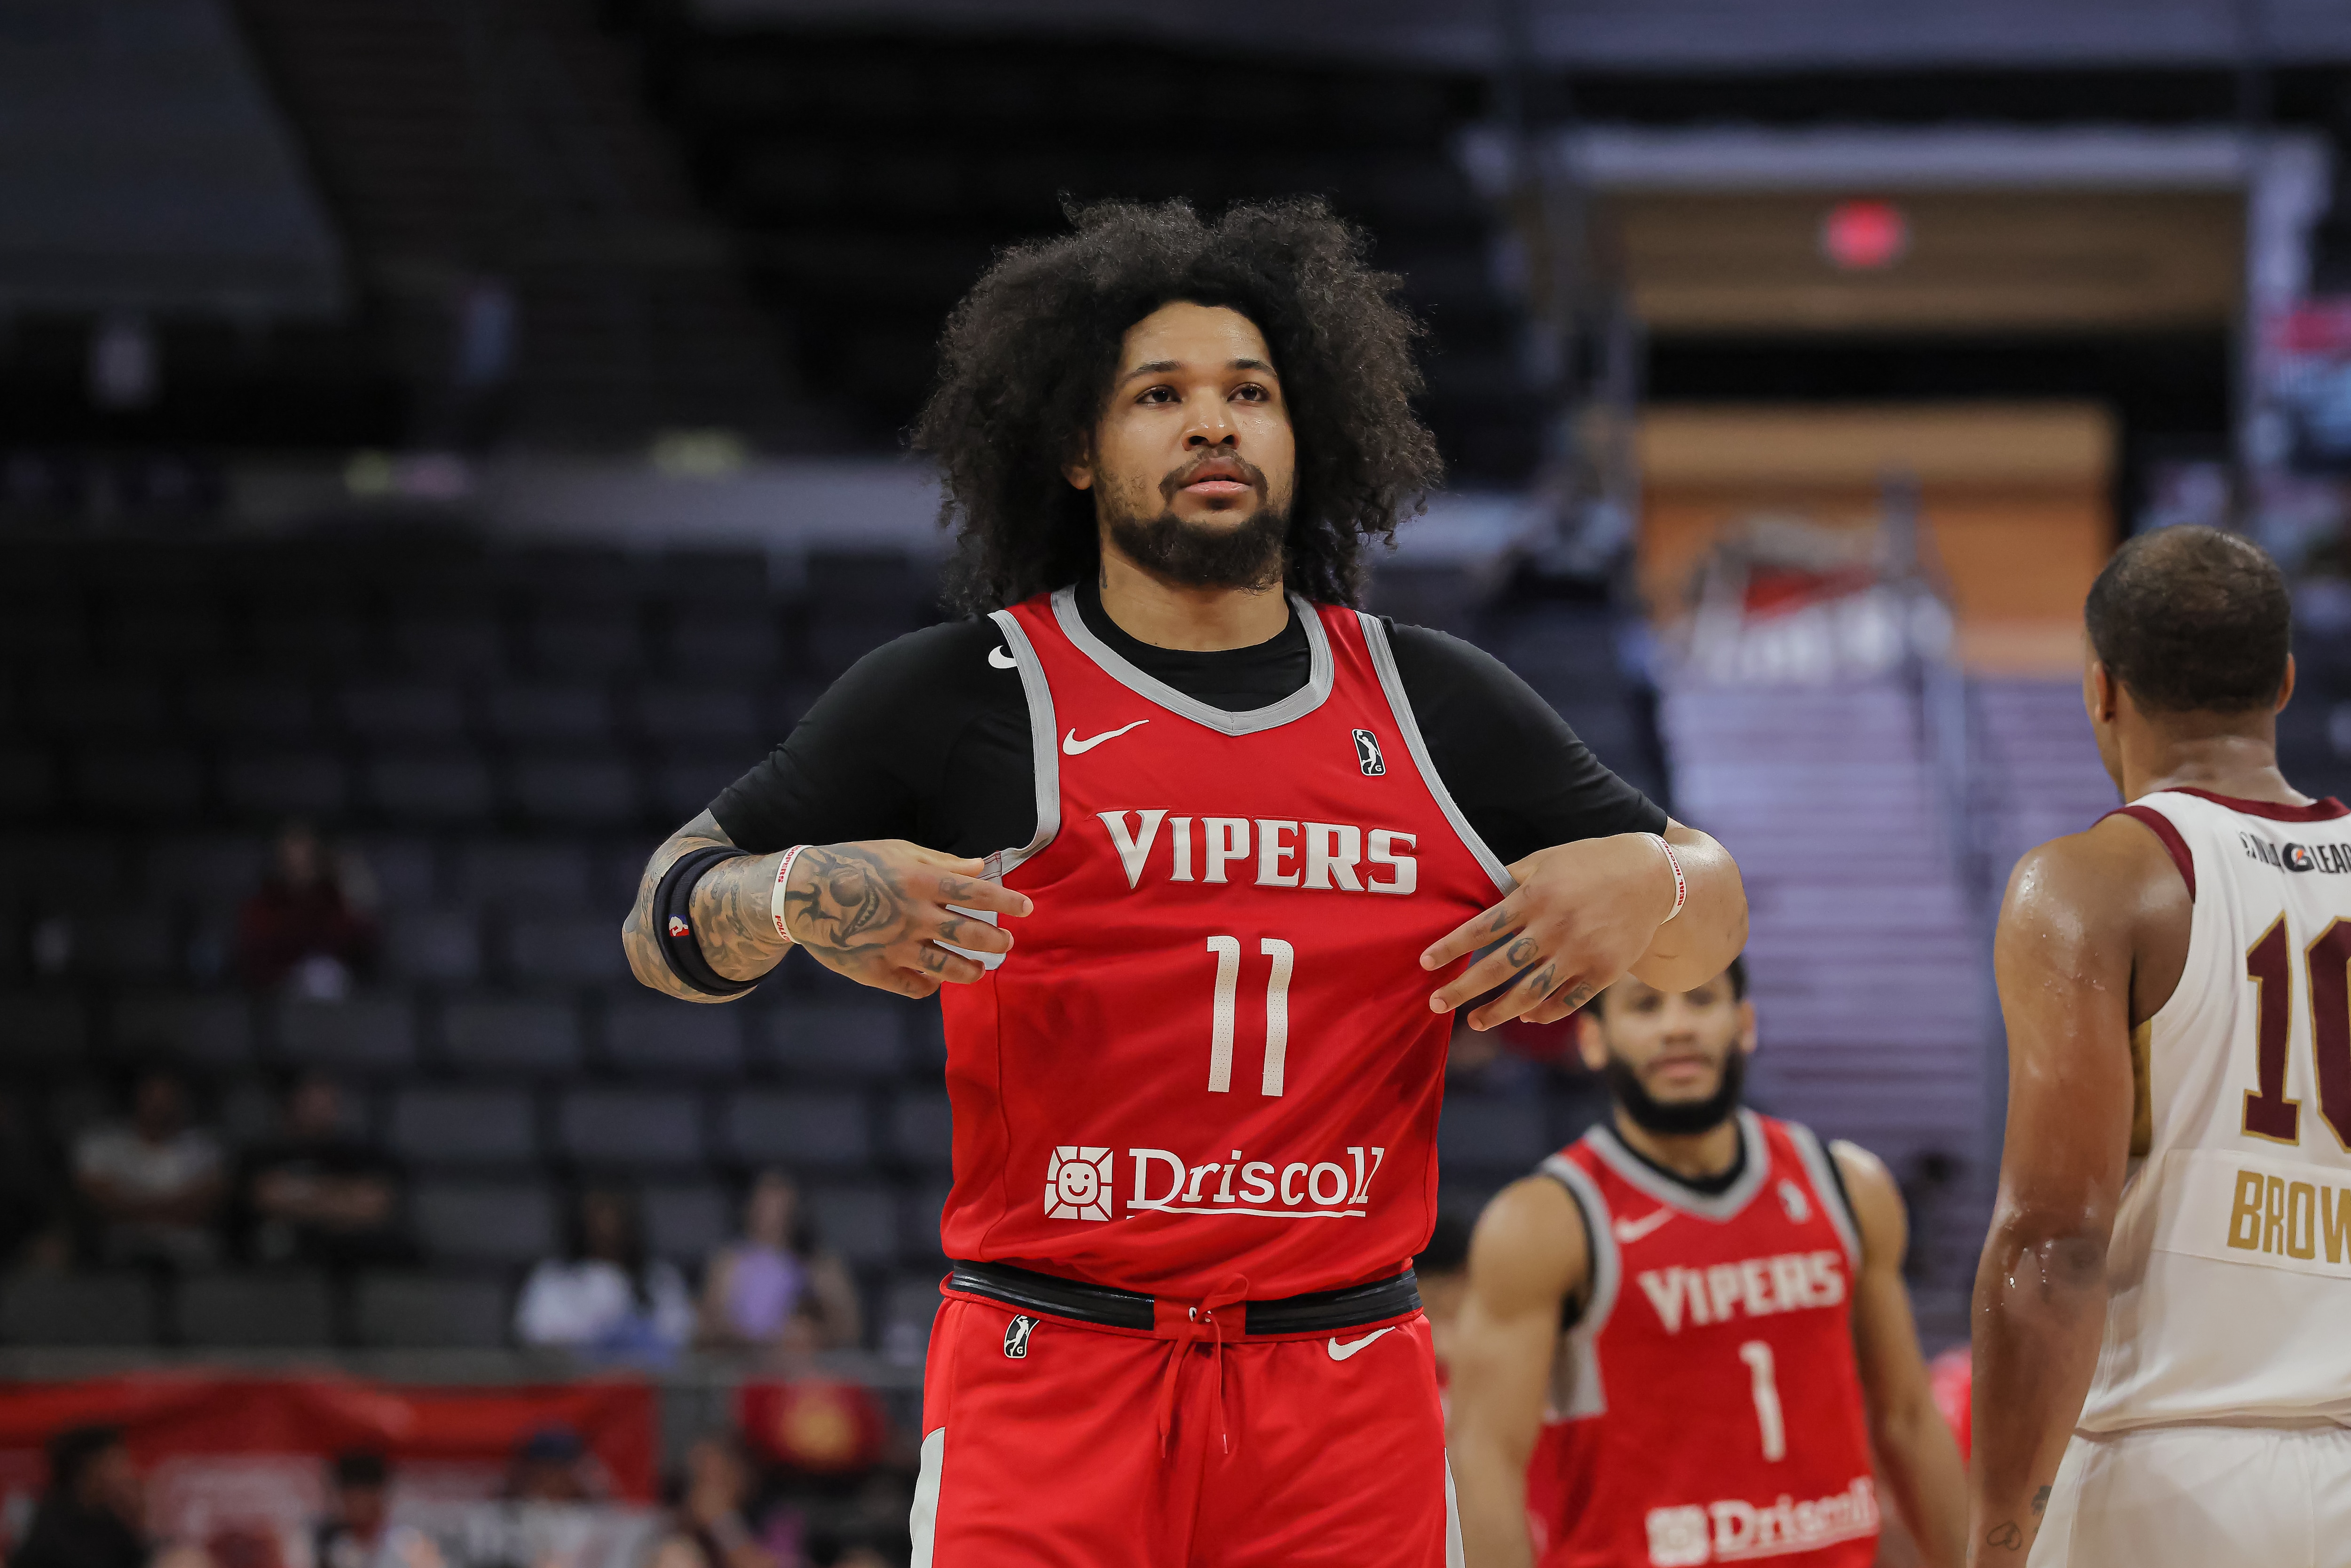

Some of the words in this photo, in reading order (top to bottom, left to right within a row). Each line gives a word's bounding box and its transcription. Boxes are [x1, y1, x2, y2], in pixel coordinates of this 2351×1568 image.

[1096, 809, 1417, 896] VIPERS
[2282, 843, 2314, 873] G
[1206, 934, 1295, 1097] 11
[1637, 1249, 1846, 1334] VIPERS
[1016, 1346, 1024, 1355] G
[1739, 1340, 1786, 1462] 1
